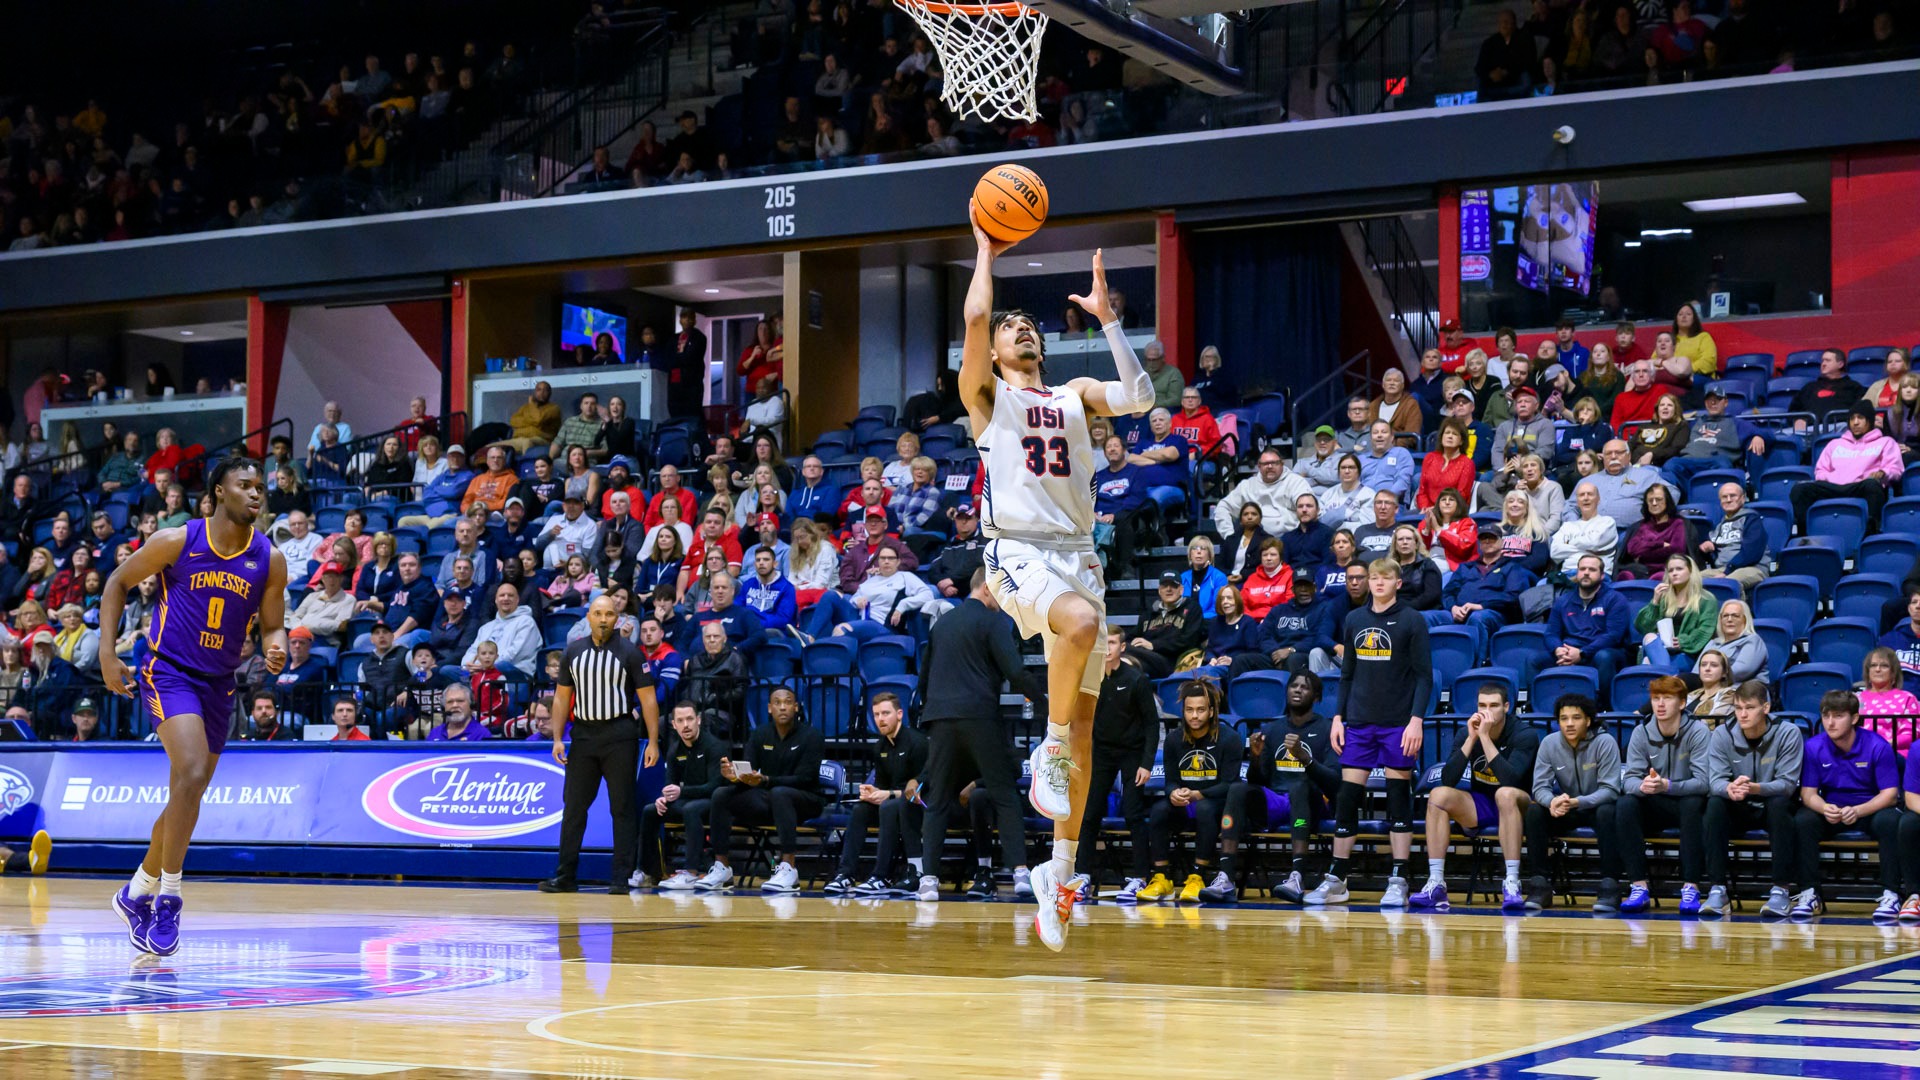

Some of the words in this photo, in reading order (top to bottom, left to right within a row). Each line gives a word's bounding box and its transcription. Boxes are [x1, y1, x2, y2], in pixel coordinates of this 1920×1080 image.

[764, 185, 796, 209] 205
[997, 170, 1039, 208] Wilson
[766, 214, 795, 238] 105
[1026, 405, 1065, 430] USI
[1021, 435, 1072, 478] 33
[190, 570, 252, 600] TENNESSEE
[1325, 572, 1346, 586] US
[207, 596, 225, 630] 0
[200, 631, 224, 650] TECH
[91, 785, 133, 803] OLD
[135, 785, 234, 804] NATNAL
[237, 786, 294, 805] BANK
[419, 767, 547, 816] Heritage
[420, 802, 509, 814] PETROLEUM
[525, 806, 545, 815] LLC
